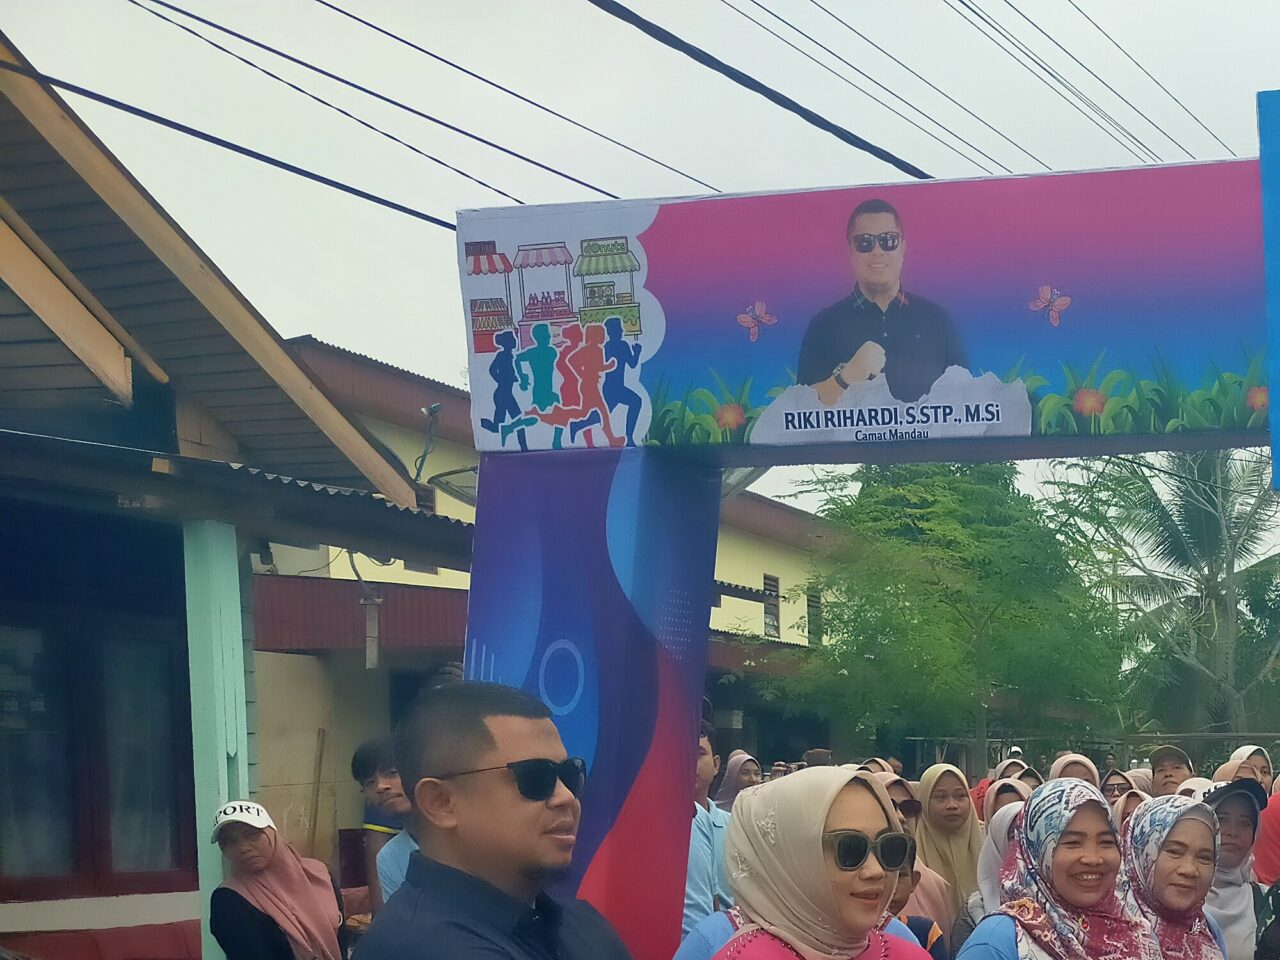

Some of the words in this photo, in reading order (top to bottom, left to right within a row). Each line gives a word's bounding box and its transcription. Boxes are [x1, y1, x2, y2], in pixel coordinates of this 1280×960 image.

[784, 411, 821, 430] RIKI
[824, 407, 903, 427] RIHARDI,
[965, 403, 1001, 422] M.Si
[855, 429, 887, 442] Camat
[889, 428, 929, 441] Mandau
